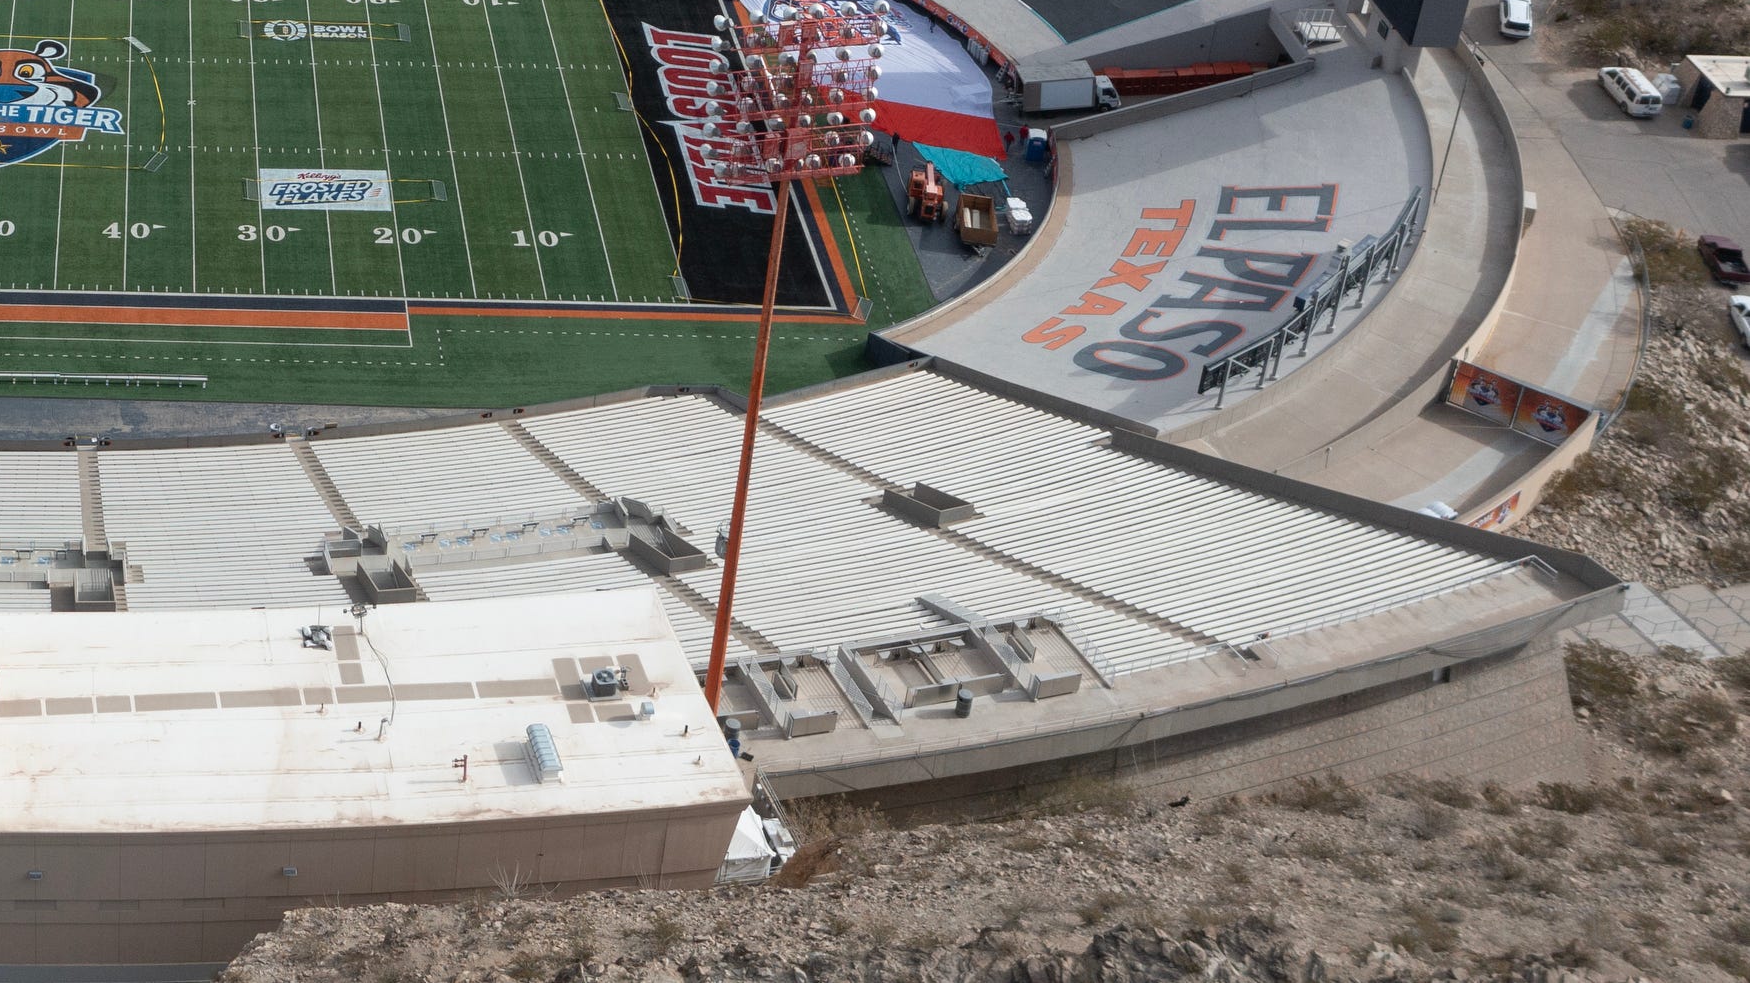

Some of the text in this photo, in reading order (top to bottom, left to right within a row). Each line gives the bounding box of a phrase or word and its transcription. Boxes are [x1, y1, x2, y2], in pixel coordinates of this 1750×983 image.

[313, 25, 367, 33] BOWL
[26, 106, 116, 130] TIGER
[269, 179, 373, 196] FROSTED
[275, 190, 365, 206] FLAKES
[102, 222, 151, 240] 40
[237, 225, 286, 242] 30
[373, 228, 423, 245] 20
[511, 230, 560, 247] 10
[1021, 199, 1196, 350] TEXAS
[1073, 183, 1340, 382] EL PASO
